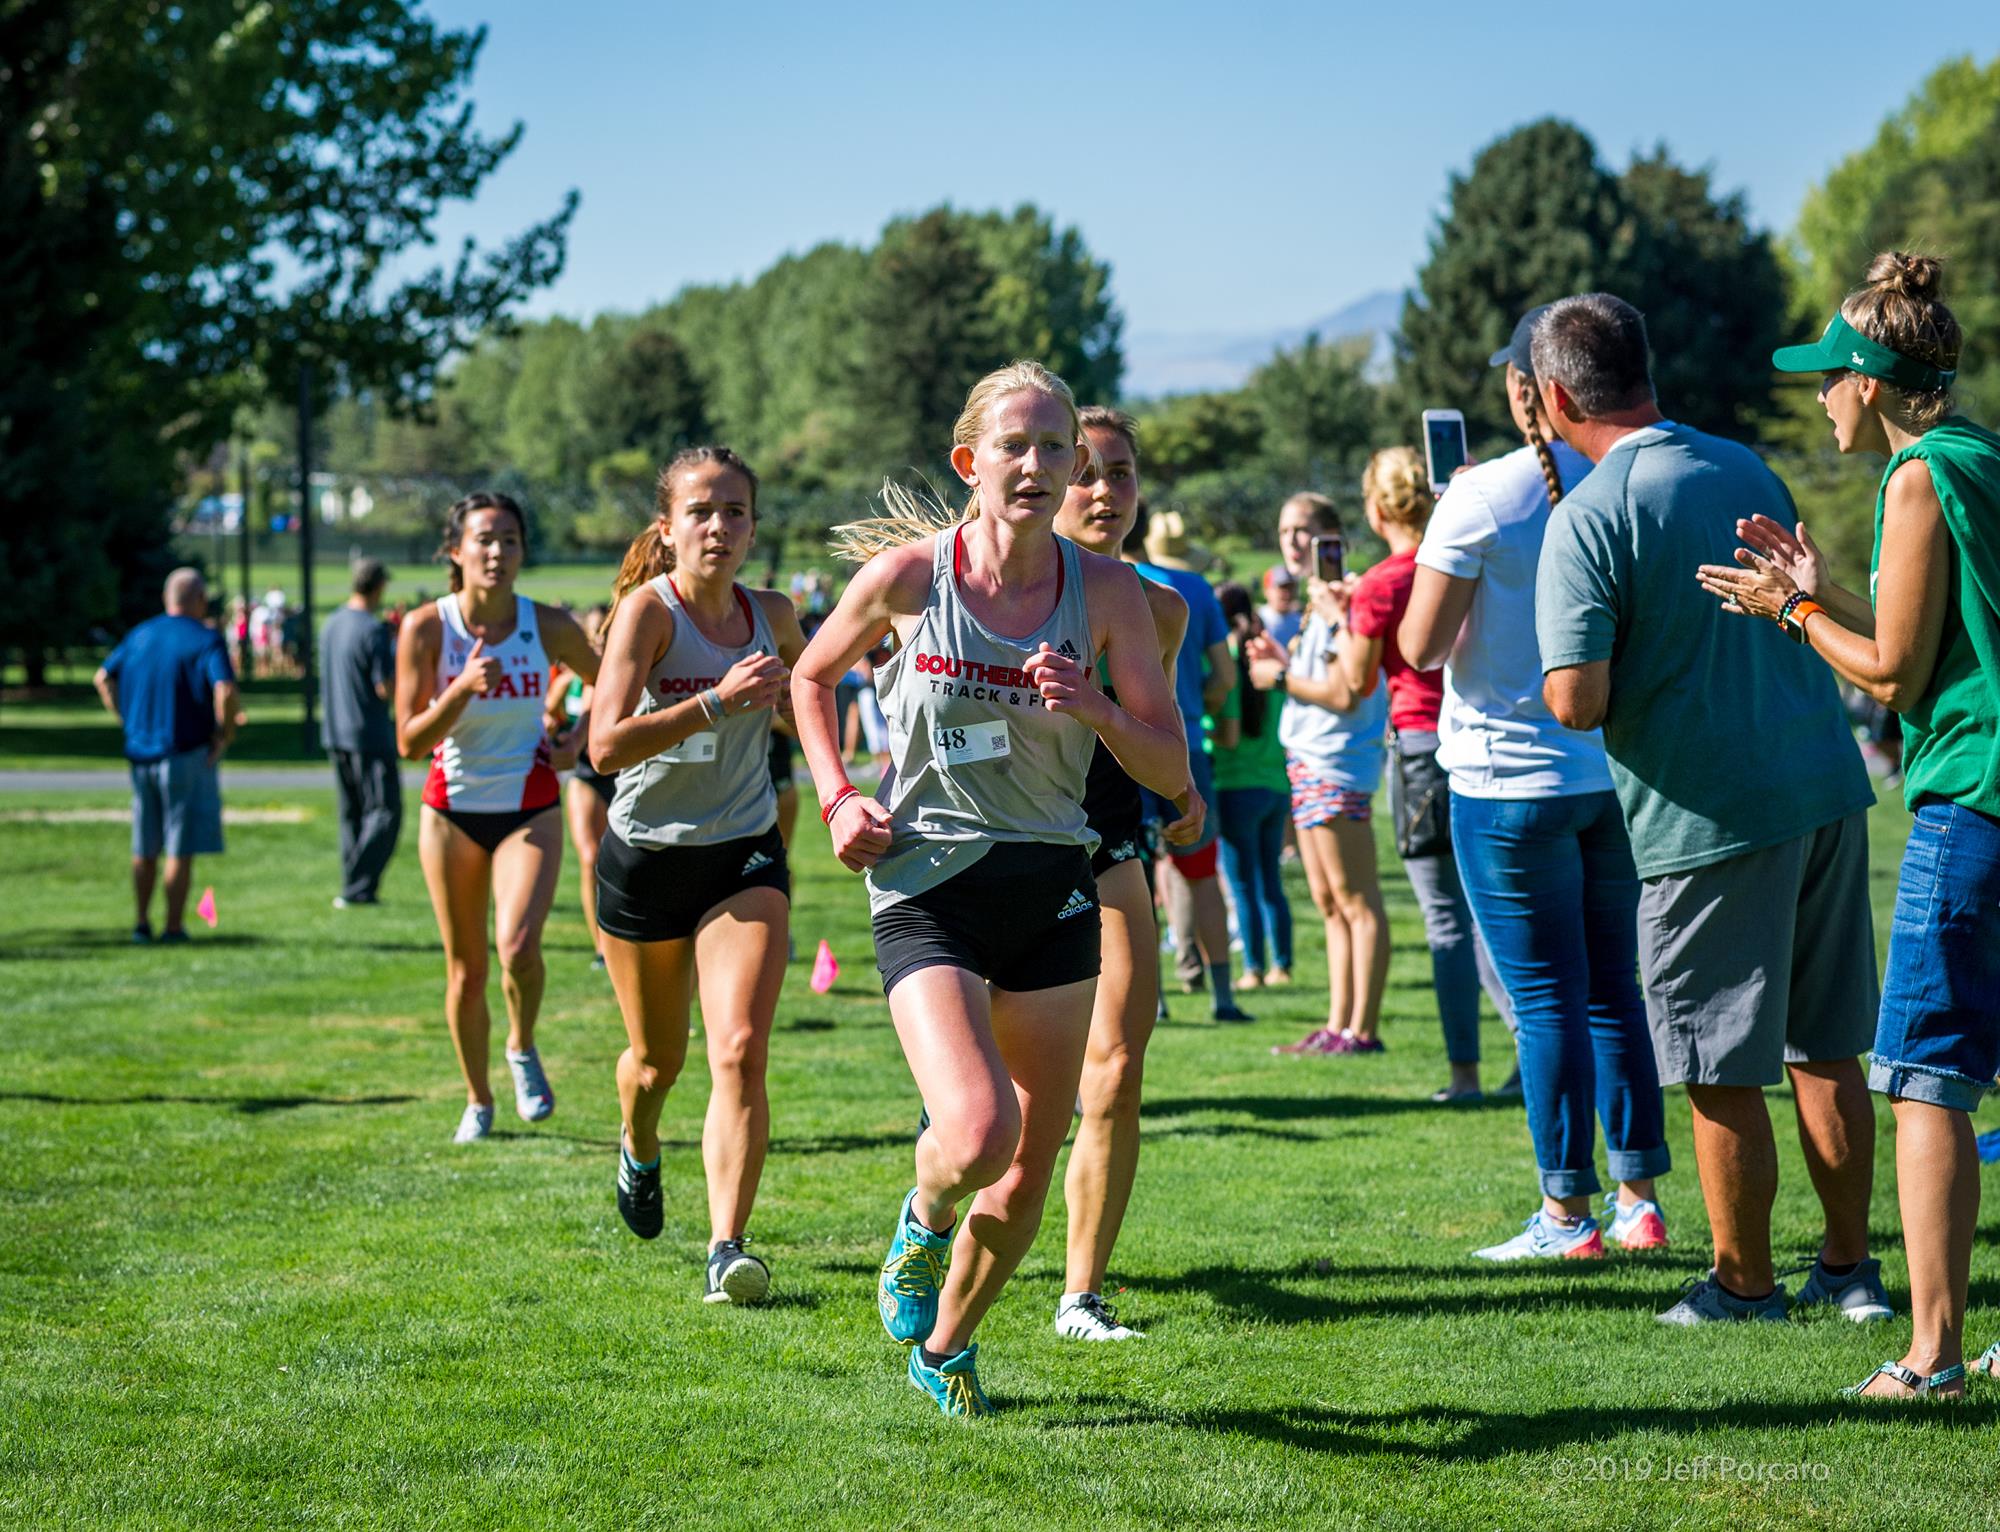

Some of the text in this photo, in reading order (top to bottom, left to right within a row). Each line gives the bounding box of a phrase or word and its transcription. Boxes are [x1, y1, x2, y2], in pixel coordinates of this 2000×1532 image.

[447, 672, 540, 698] AH
[659, 676, 724, 695] SOUT
[929, 679, 1000, 703] TRACK
[1009, 692, 1021, 706] &
[1057, 900, 1094, 919] adidas
